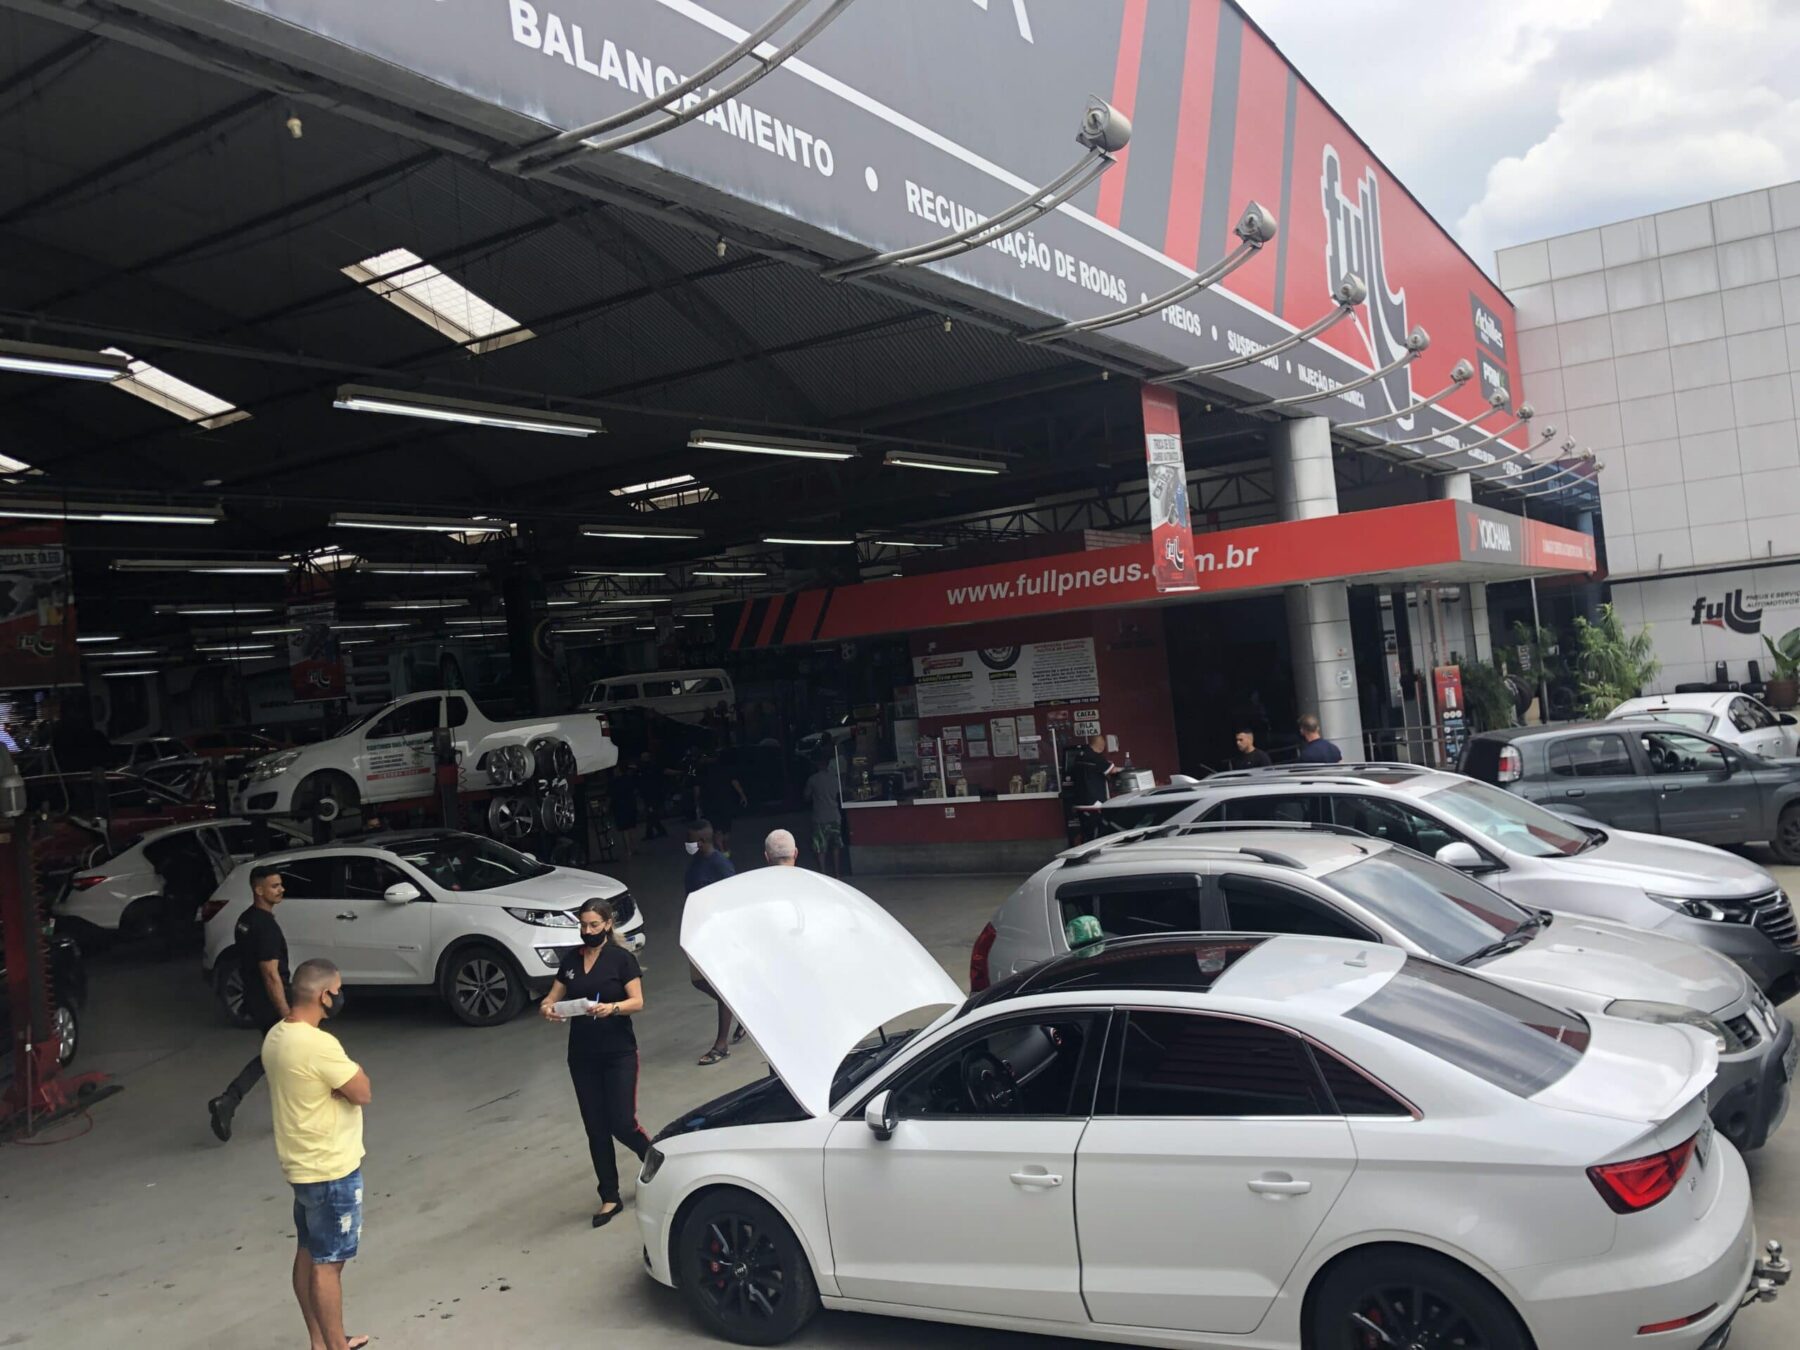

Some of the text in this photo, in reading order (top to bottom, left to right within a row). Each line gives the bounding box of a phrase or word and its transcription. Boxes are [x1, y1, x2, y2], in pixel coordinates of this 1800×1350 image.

[1054, 249, 1077, 284] DE
[1079, 260, 1128, 304] RODAS
[946, 543, 1260, 606] www.fullpneus.m.br
